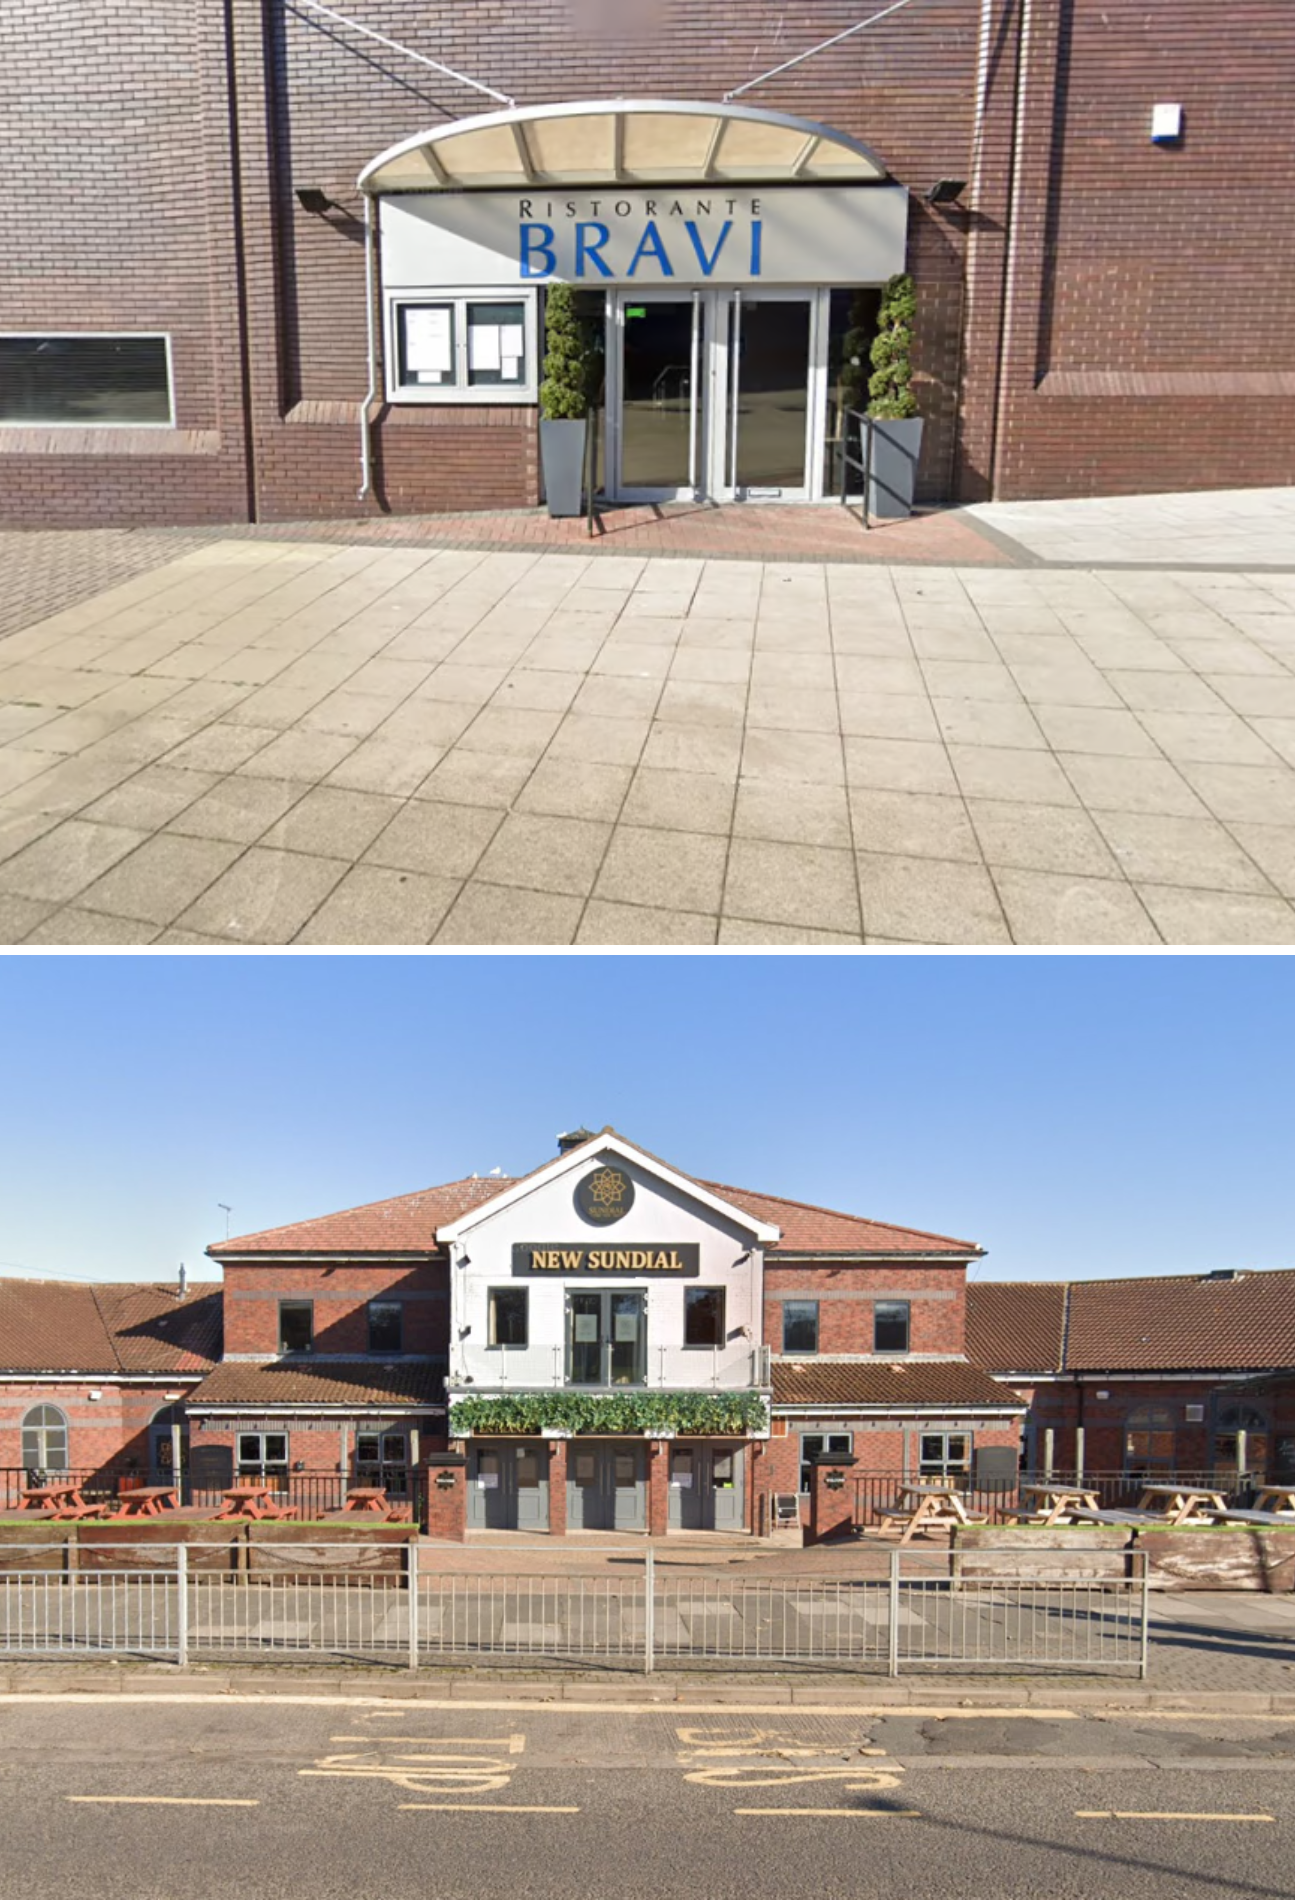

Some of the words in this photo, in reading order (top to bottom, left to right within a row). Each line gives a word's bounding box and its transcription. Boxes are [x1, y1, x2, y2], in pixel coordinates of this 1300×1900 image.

[519, 199, 762, 218] RISTORANTE
[519, 220, 762, 278] BRAVI
[532, 1251, 582, 1269] NEW
[588, 1251, 683, 1269] SUNDIAL
